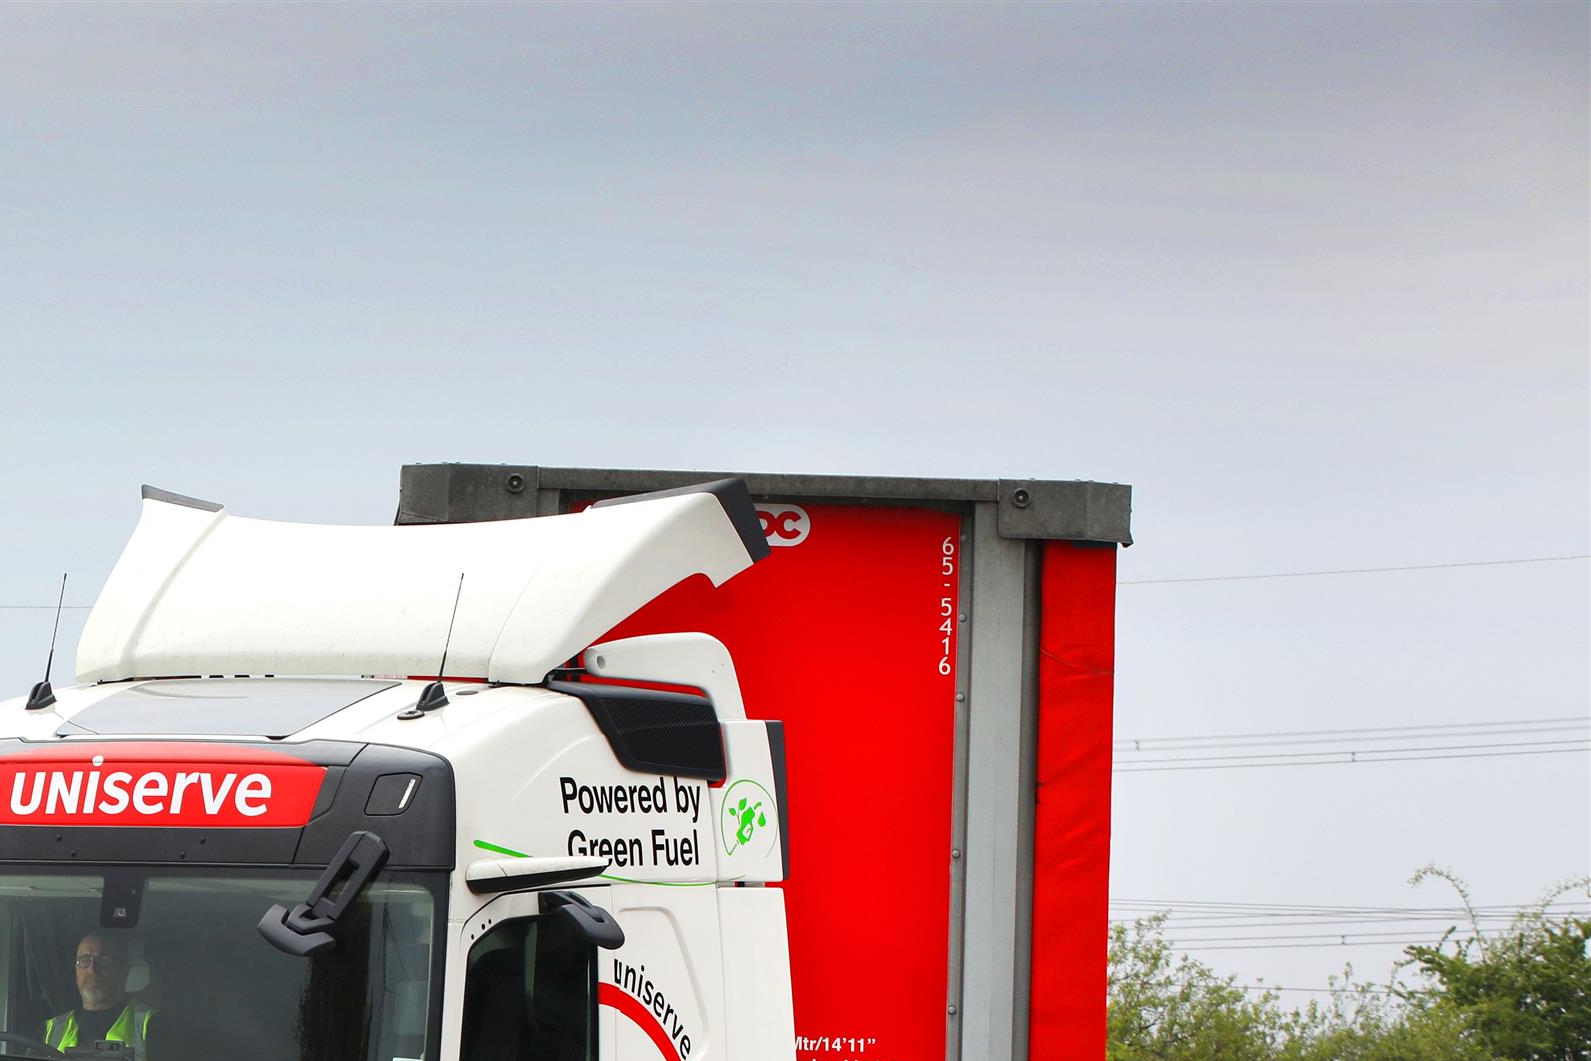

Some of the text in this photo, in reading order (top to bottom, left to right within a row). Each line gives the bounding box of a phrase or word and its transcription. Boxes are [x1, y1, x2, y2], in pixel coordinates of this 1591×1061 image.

[755, 510, 802, 540] DC
[937, 536, 955, 675] 65-5416
[559, 776, 701, 824] Powered by
[567, 828, 700, 868] Green Fuel
